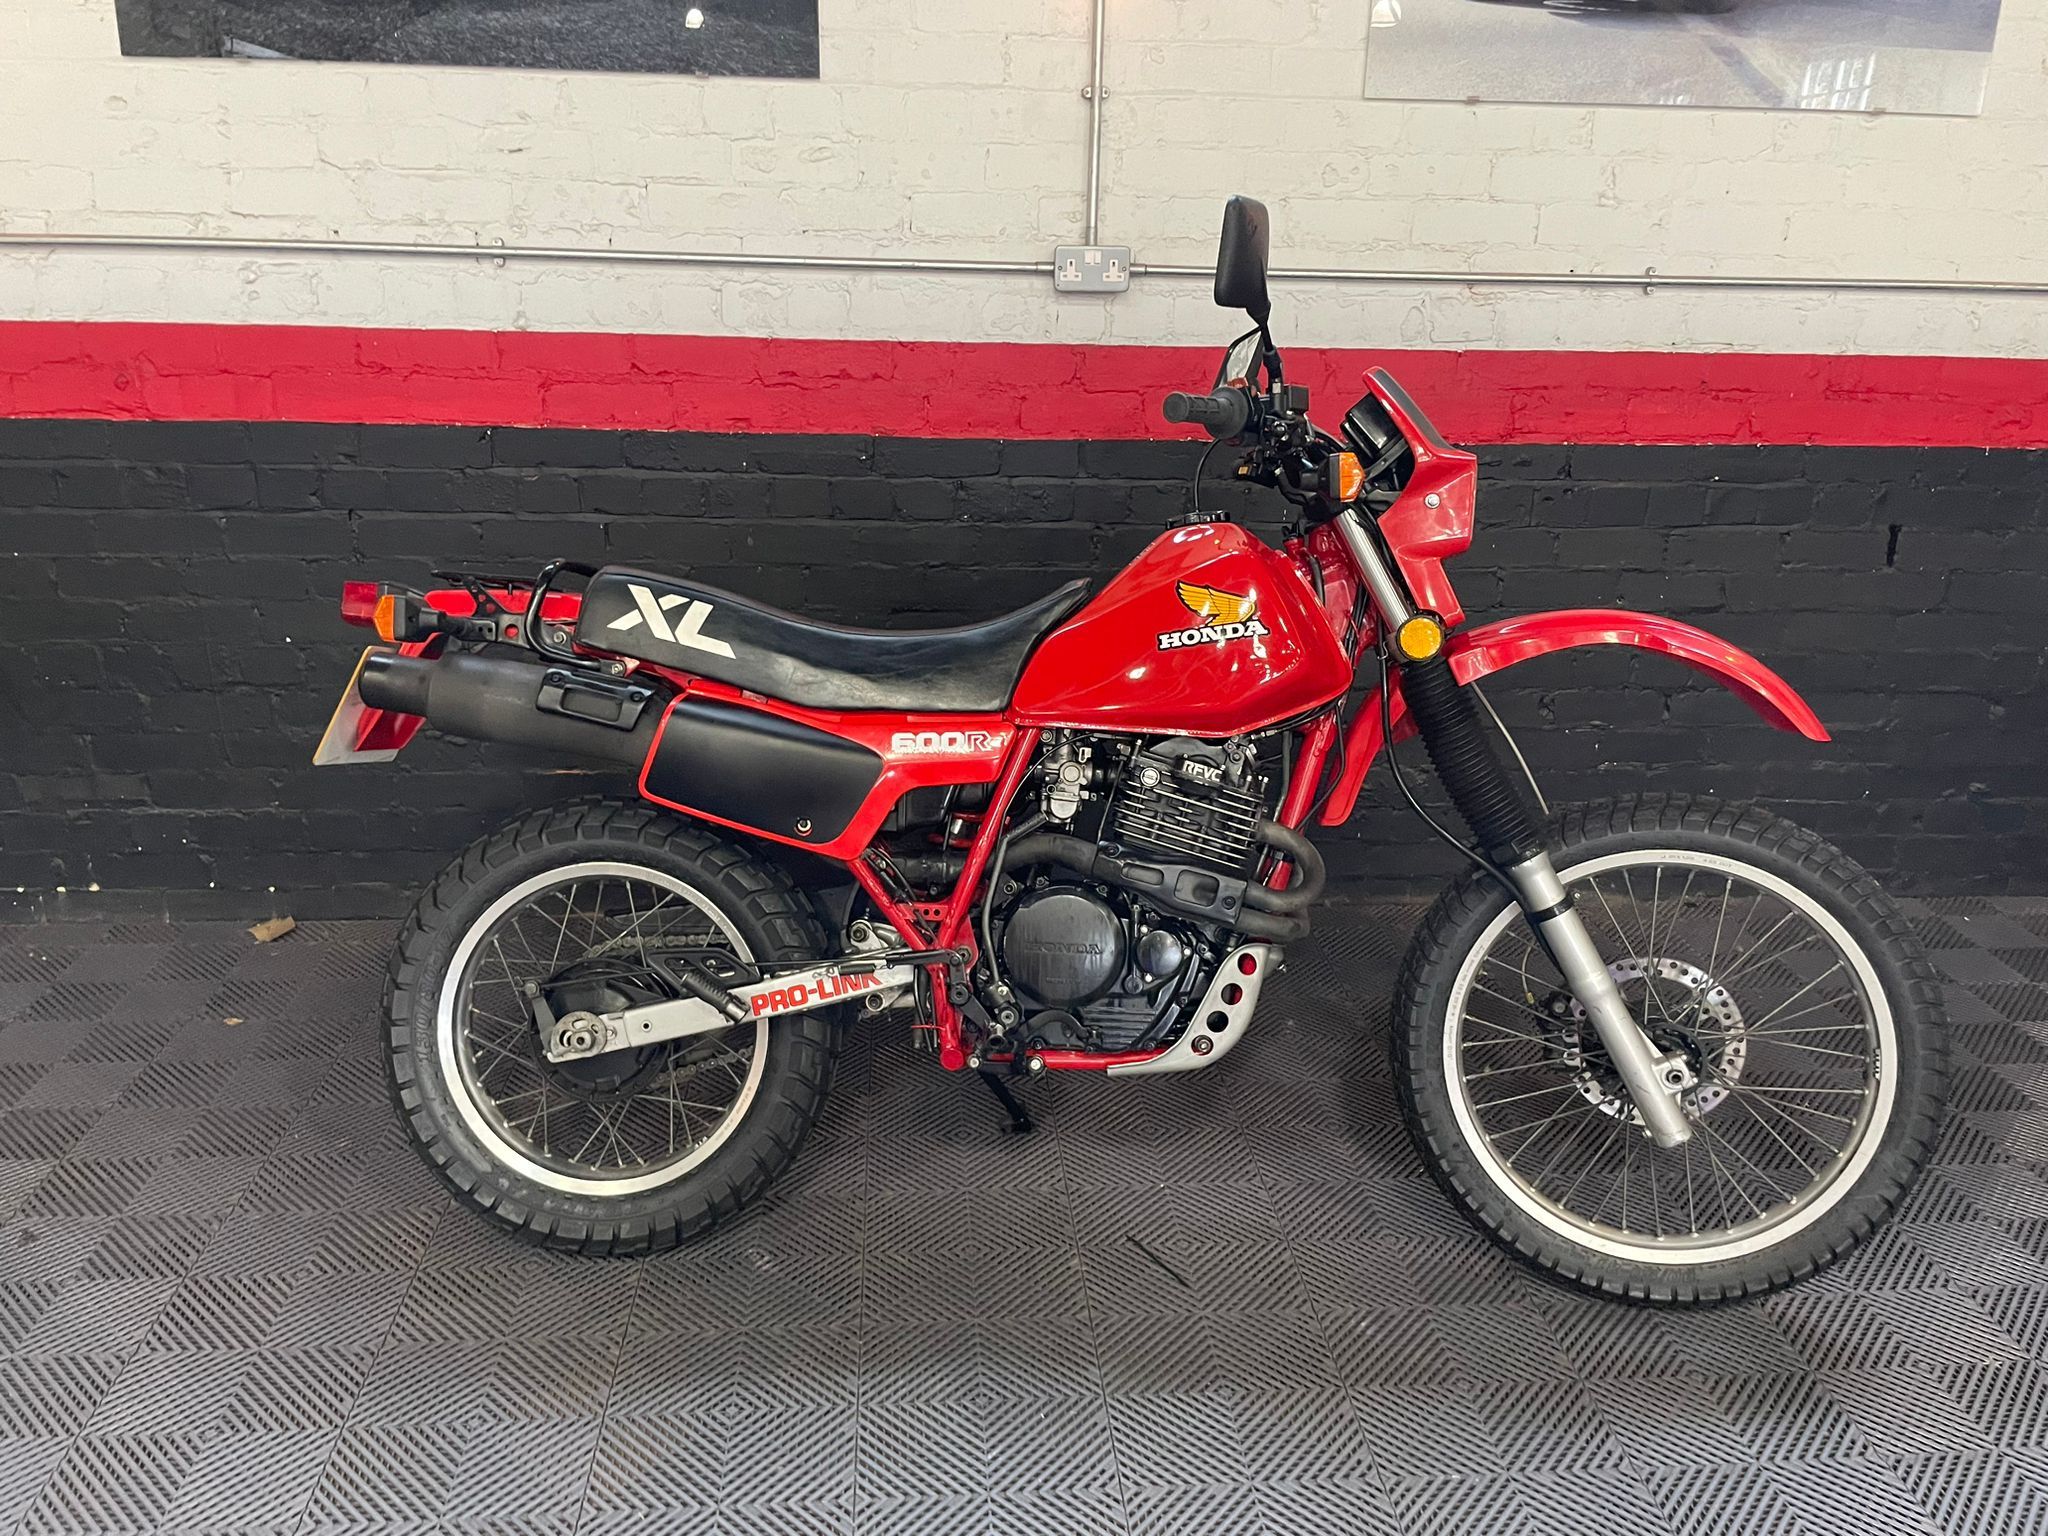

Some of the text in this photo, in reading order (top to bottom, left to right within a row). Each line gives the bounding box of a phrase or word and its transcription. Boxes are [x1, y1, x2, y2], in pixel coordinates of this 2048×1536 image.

[607, 584, 736, 659] XL
[1158, 620, 1269, 650] HONDA
[891, 731, 993, 753] 600R
[1182, 760, 1223, 783] RFVC
[1024, 942, 1104, 955] HONDA
[751, 973, 884, 1017] PRO-LINK
